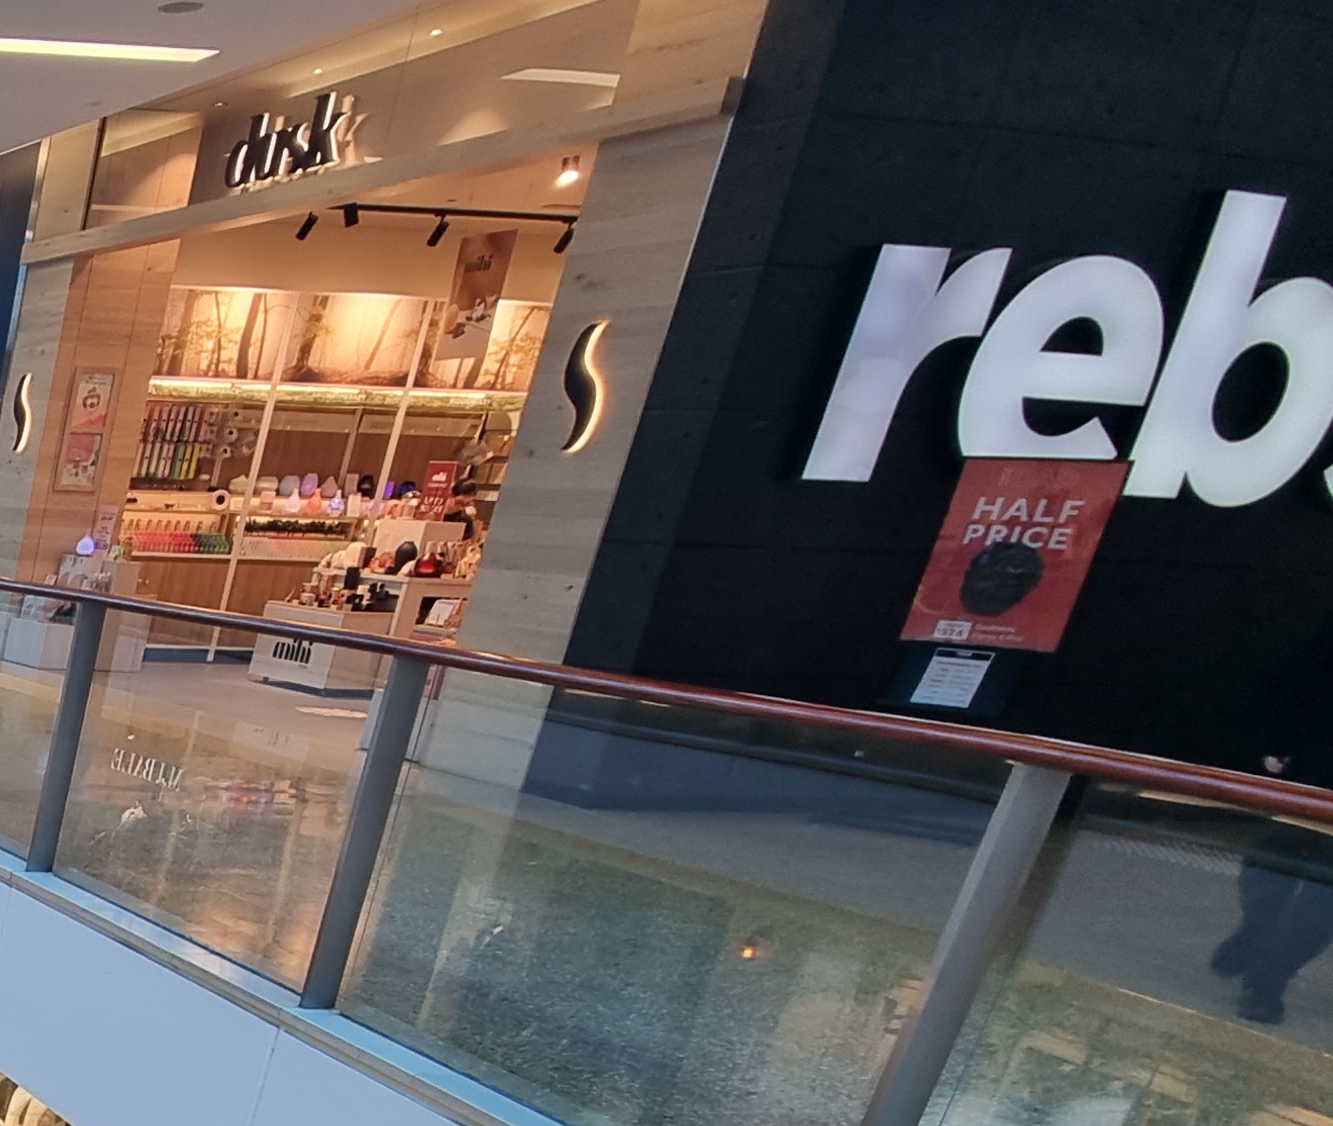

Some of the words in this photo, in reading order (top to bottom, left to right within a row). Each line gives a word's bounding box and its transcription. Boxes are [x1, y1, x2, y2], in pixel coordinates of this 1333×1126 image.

[225, 91, 352, 189] dusk
[801, 189, 1333, 508] reb
[962, 524, 1073, 550] PRICE
[971, 497, 1086, 524] HALF
